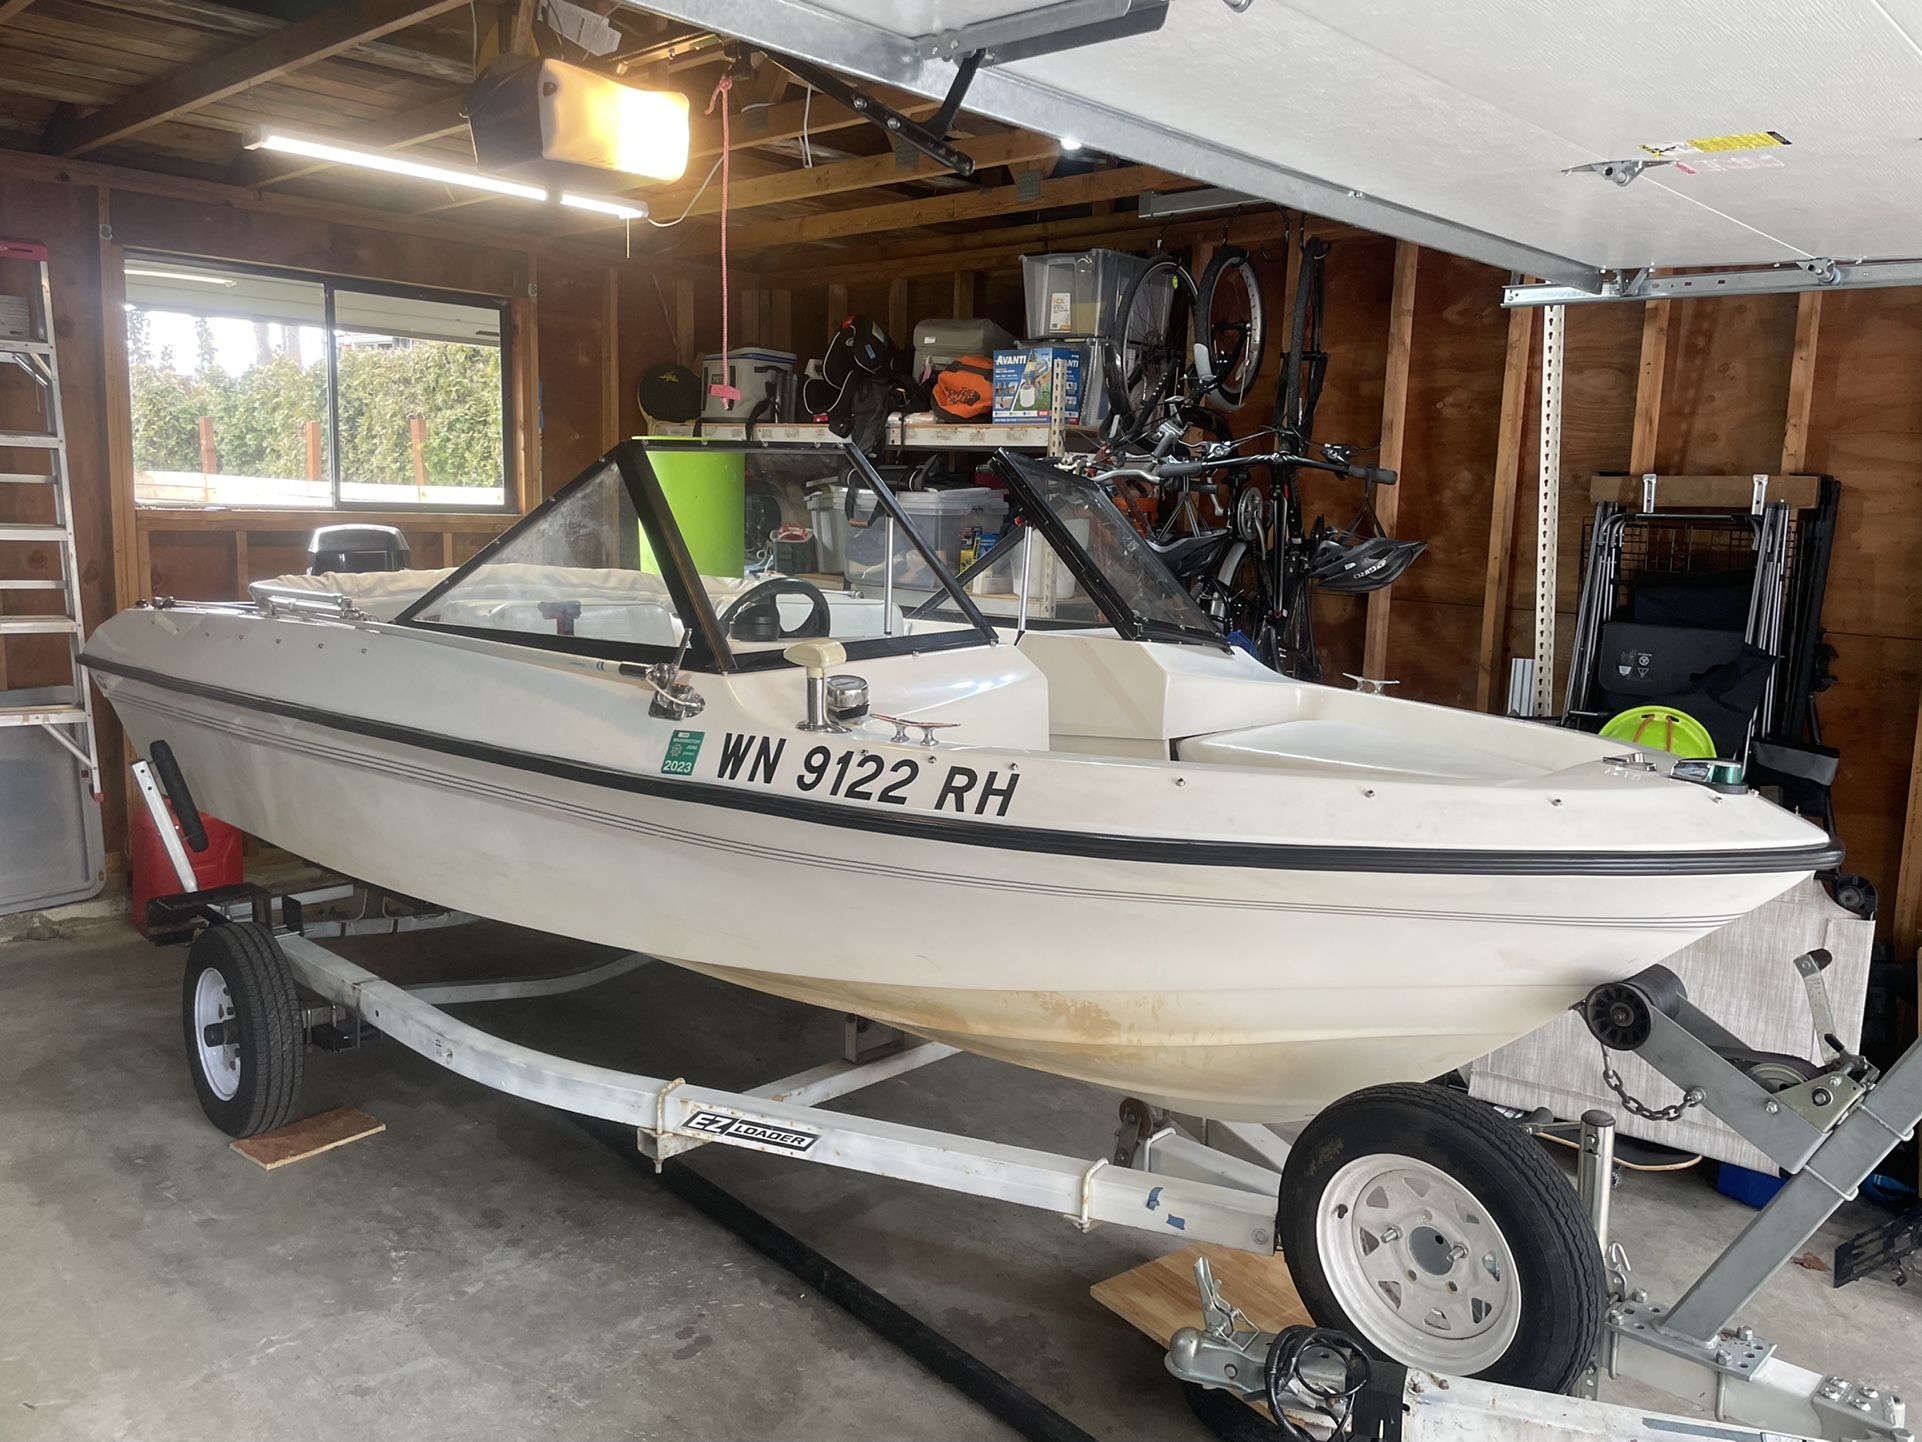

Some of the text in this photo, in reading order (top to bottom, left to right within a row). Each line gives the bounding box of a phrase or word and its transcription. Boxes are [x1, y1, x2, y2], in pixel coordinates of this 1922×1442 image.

[996, 355, 1027, 365] AVANTI
[663, 760, 692, 773] 2023
[717, 733, 1020, 816] WN 9122 RH
[688, 1112, 806, 1146] EZ LOADER
